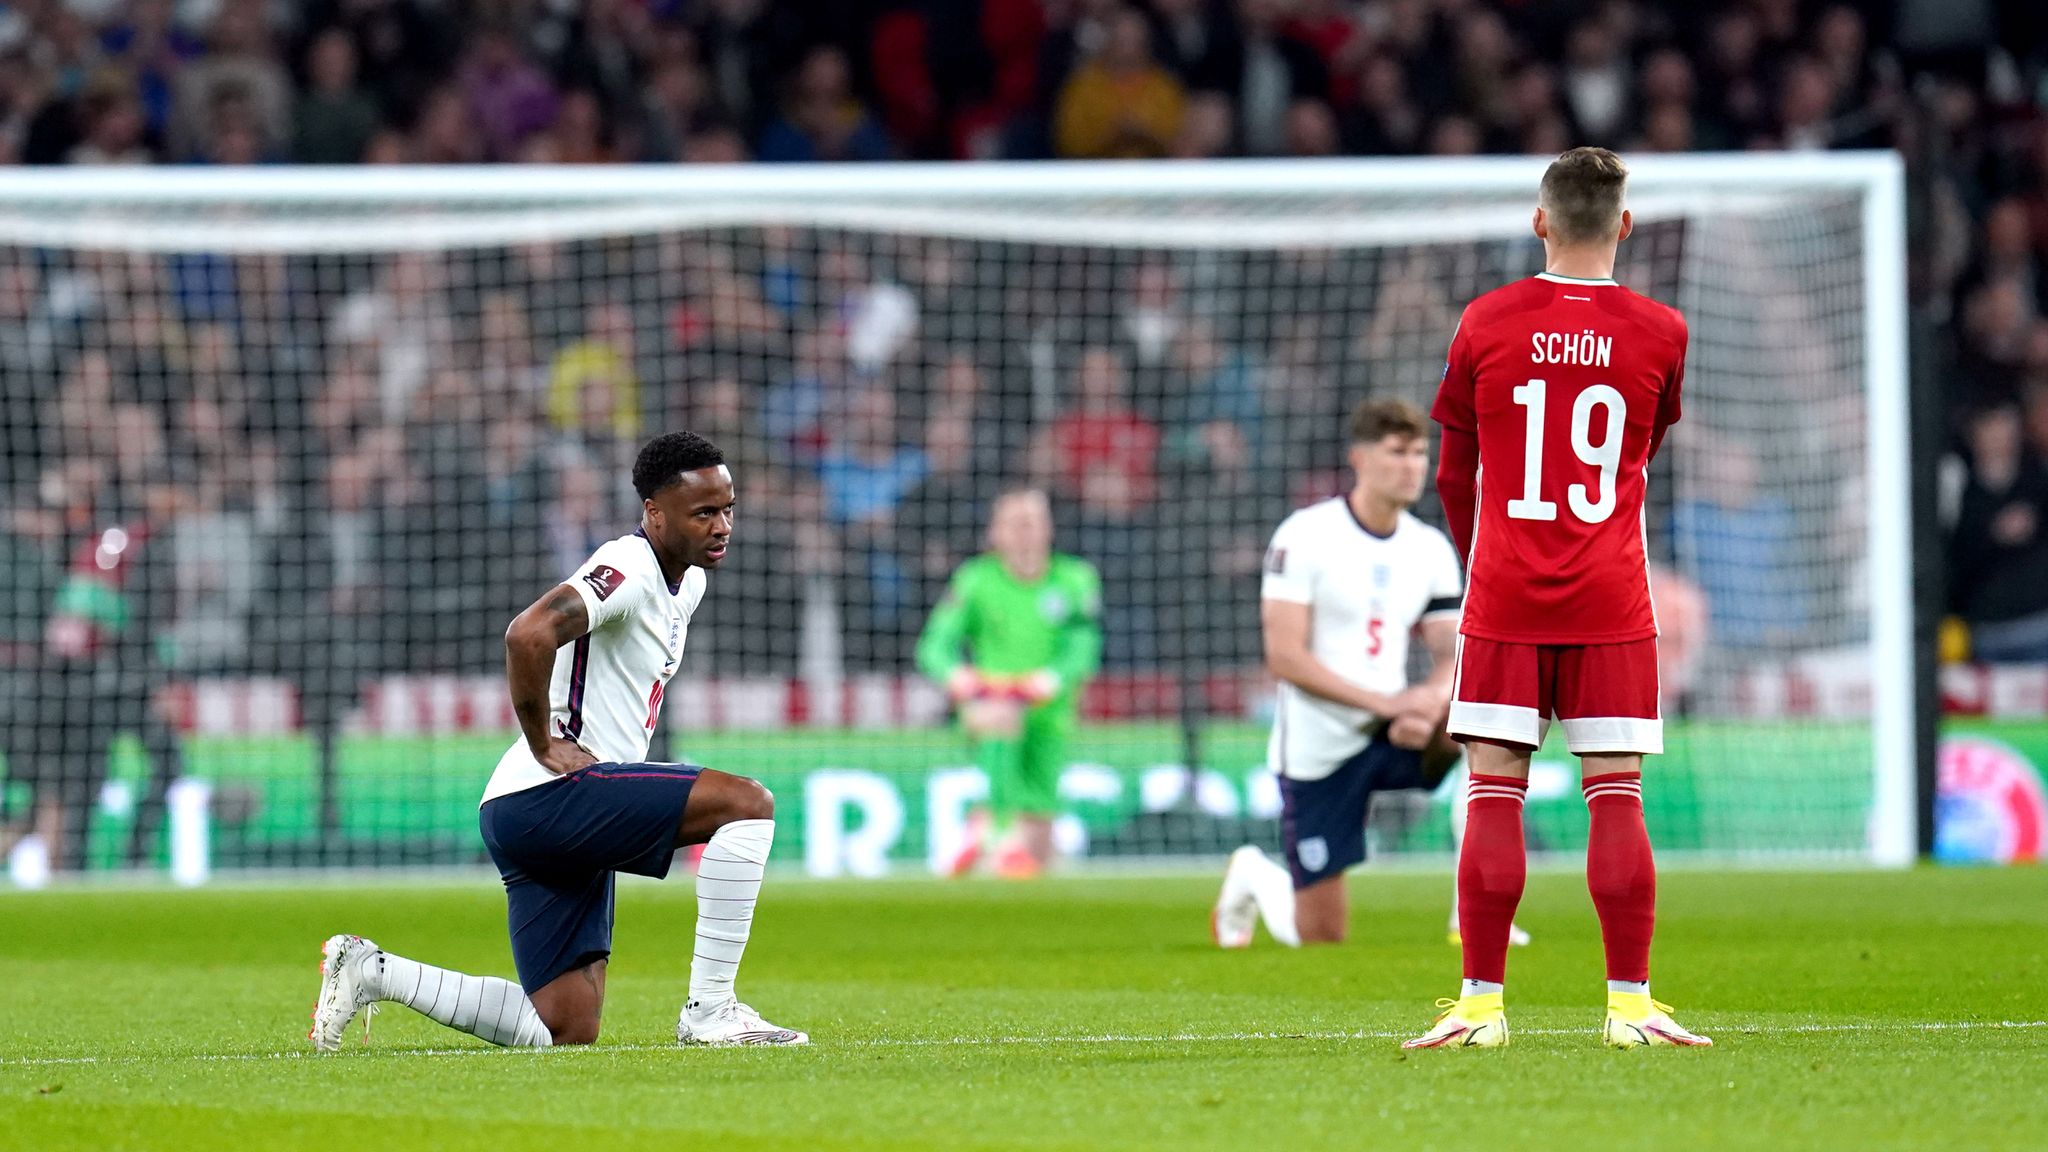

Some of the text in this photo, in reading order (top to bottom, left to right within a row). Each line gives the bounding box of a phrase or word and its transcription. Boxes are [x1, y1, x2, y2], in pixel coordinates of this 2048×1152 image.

[1531, 329, 1612, 367] SCHÖN
[1507, 379, 1627, 523] 19
[1366, 618, 1383, 657] 5
